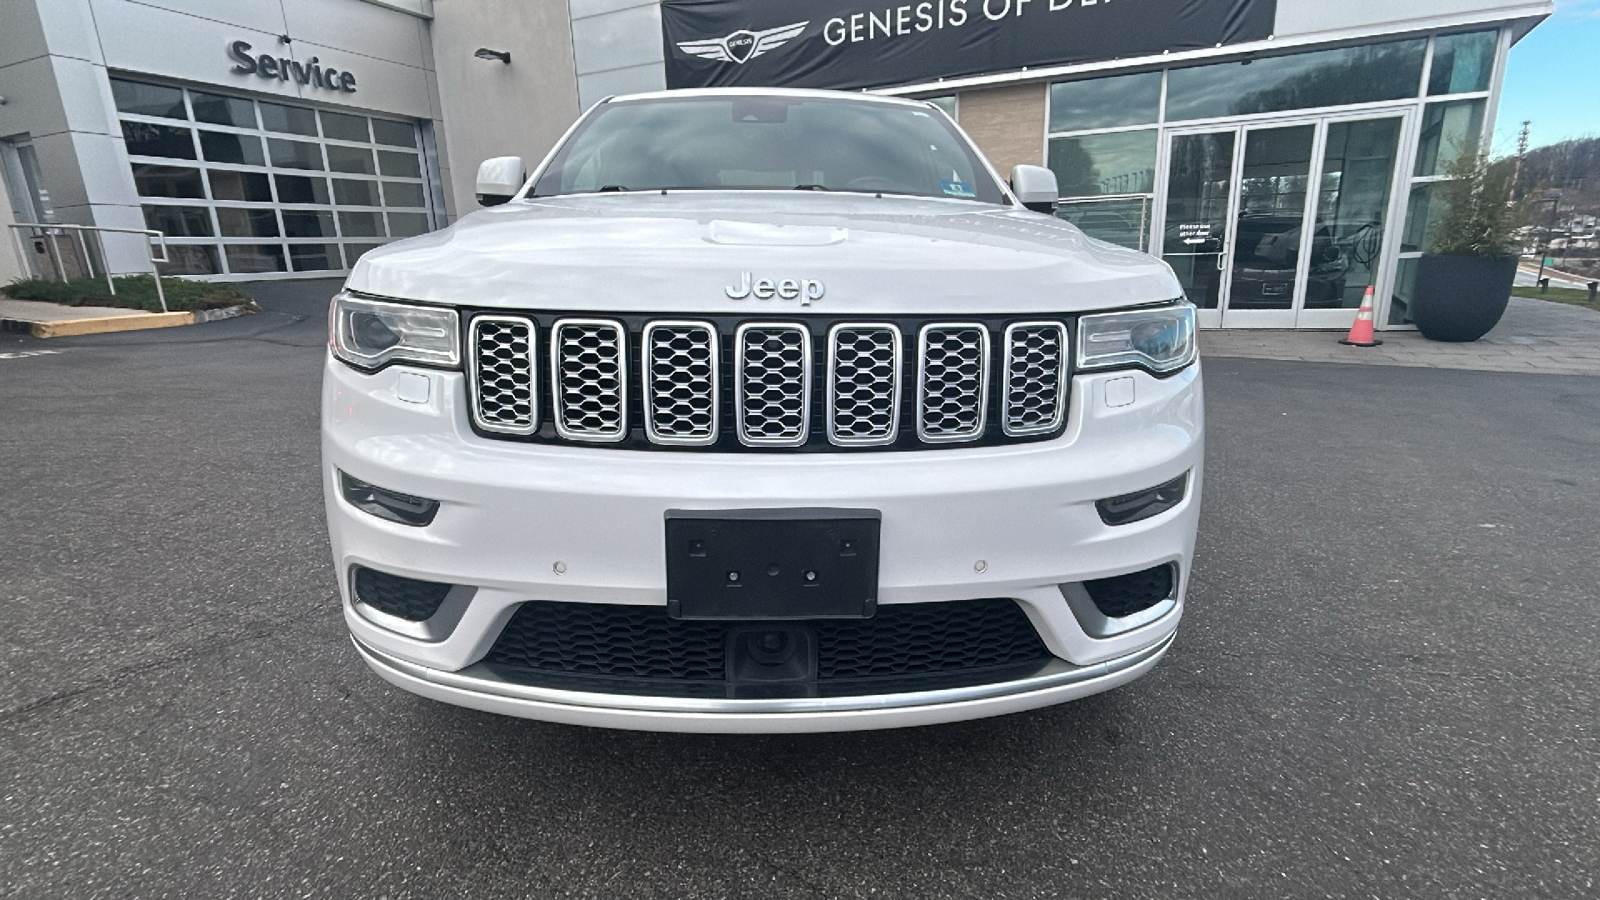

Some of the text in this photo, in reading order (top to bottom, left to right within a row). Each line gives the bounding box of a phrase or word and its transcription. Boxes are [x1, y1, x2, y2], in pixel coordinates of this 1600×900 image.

[823, 0, 968, 46] GENESIS
[230, 40, 357, 93] Service
[725, 271, 825, 307] Jeep
